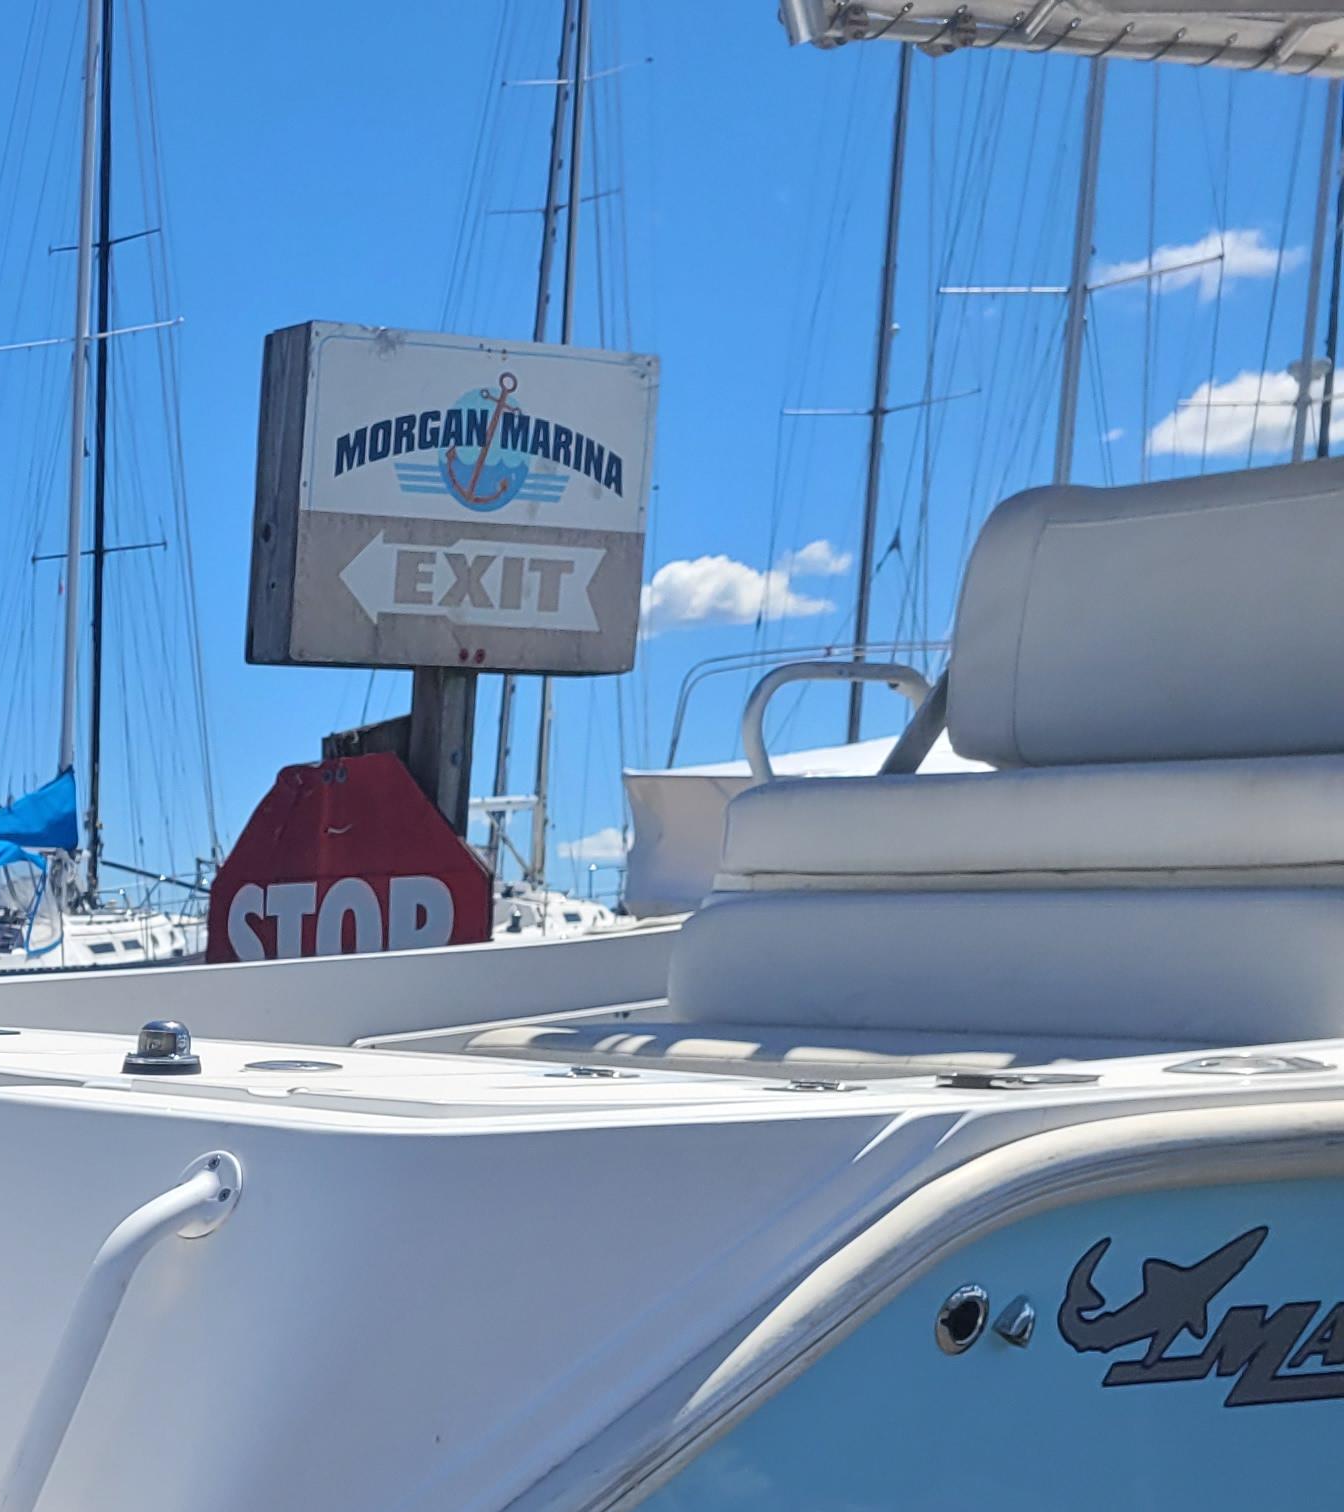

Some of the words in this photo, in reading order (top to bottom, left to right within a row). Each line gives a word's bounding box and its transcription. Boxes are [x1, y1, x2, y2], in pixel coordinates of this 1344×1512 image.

[334, 408, 489, 478] MORGAN
[501, 411, 623, 498] MARINA
[393, 550, 575, 613] EXIT
[228, 875, 455, 962] STOP
